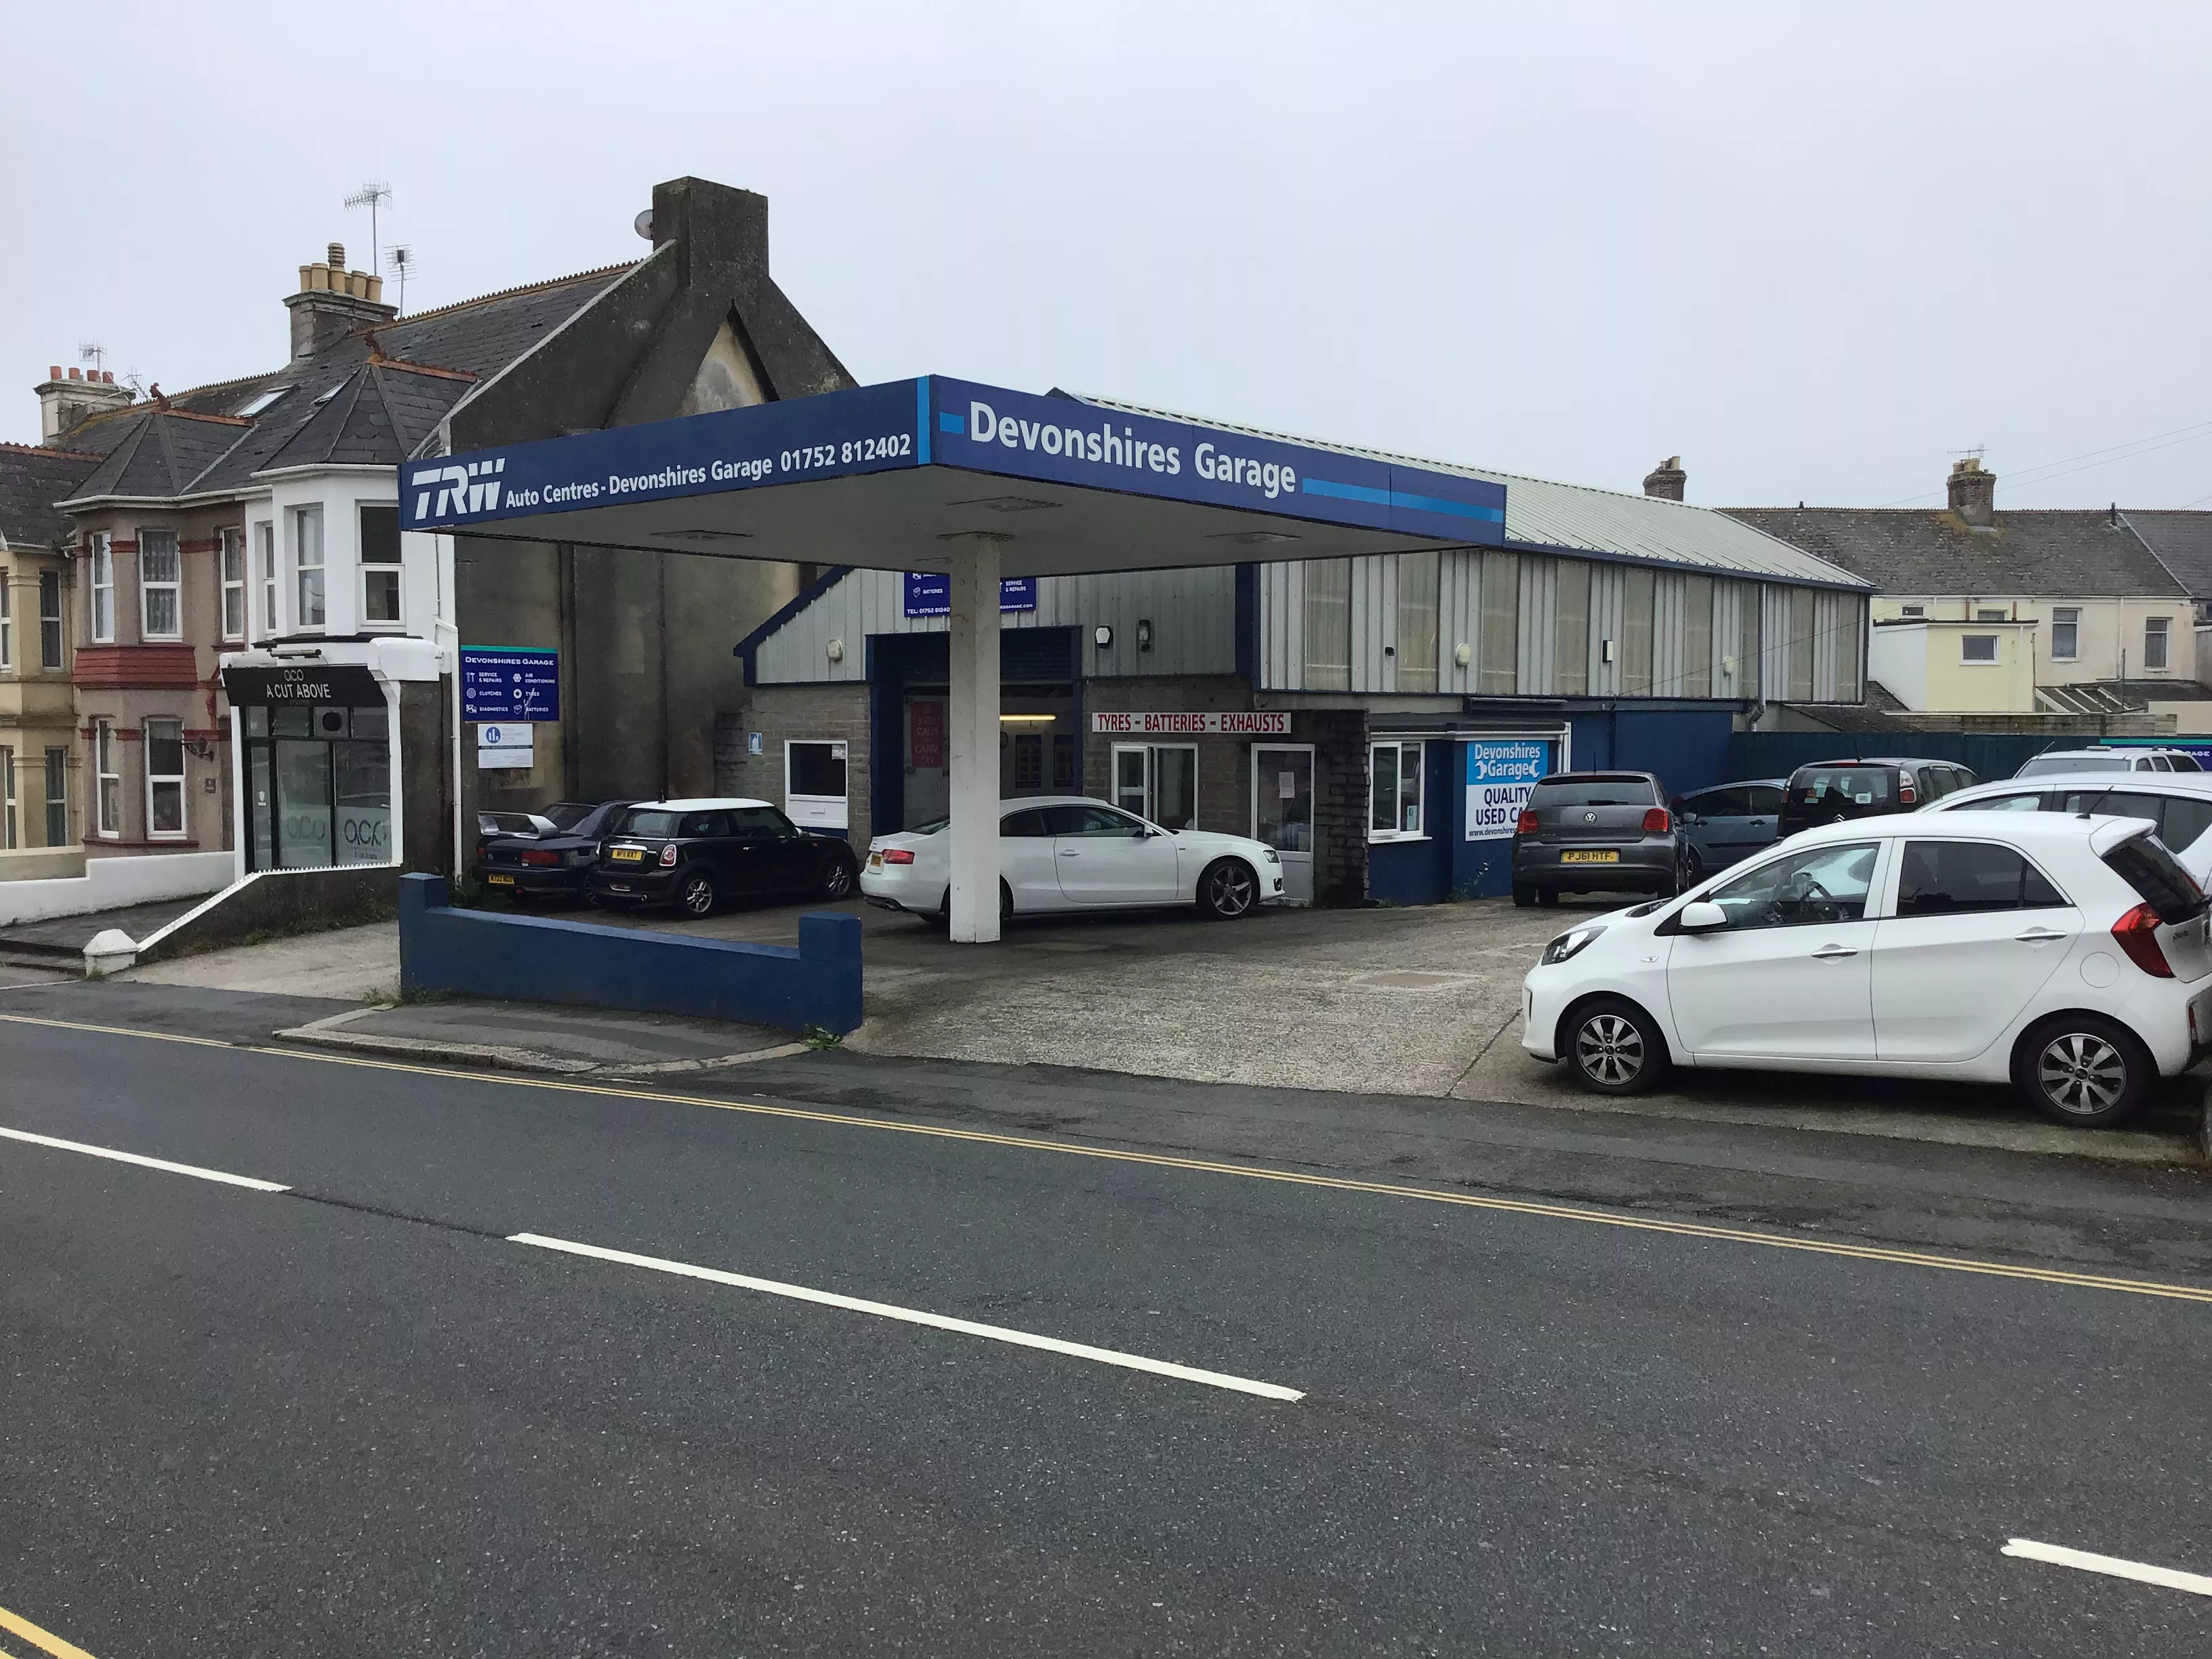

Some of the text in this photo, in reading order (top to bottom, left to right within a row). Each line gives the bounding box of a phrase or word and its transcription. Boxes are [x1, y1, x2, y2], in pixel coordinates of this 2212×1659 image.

[970, 401, 1296, 499] Devonshires Garage
[506, 488, 539, 508] Auto
[543, 482, 599, 504] Centres
[609, 465, 706, 494] Devonshires
[712, 458, 773, 481] Garage
[781, 445, 835, 472] 01752
[842, 433, 911, 464] 812402
[412, 458, 506, 520] TRW
[465, 656, 521, 664] DEVONSHIRES
[284, 669, 304, 682] OCO
[266, 683, 331, 698] A CUT ABOVE
[1098, 714, 1131, 731] TYRES
[1145, 714, 1206, 731] BATTERIES
[1221, 714, 1285, 732] EXHAUSTS
[1475, 742, 1540, 760] Devonshires
[1488, 760, 1530, 781] Garage
[1484, 787, 1532, 807] QUALITY
[1476, 807, 1523, 825] USED CA
[1469, 826, 1518, 836] www.devonshires
